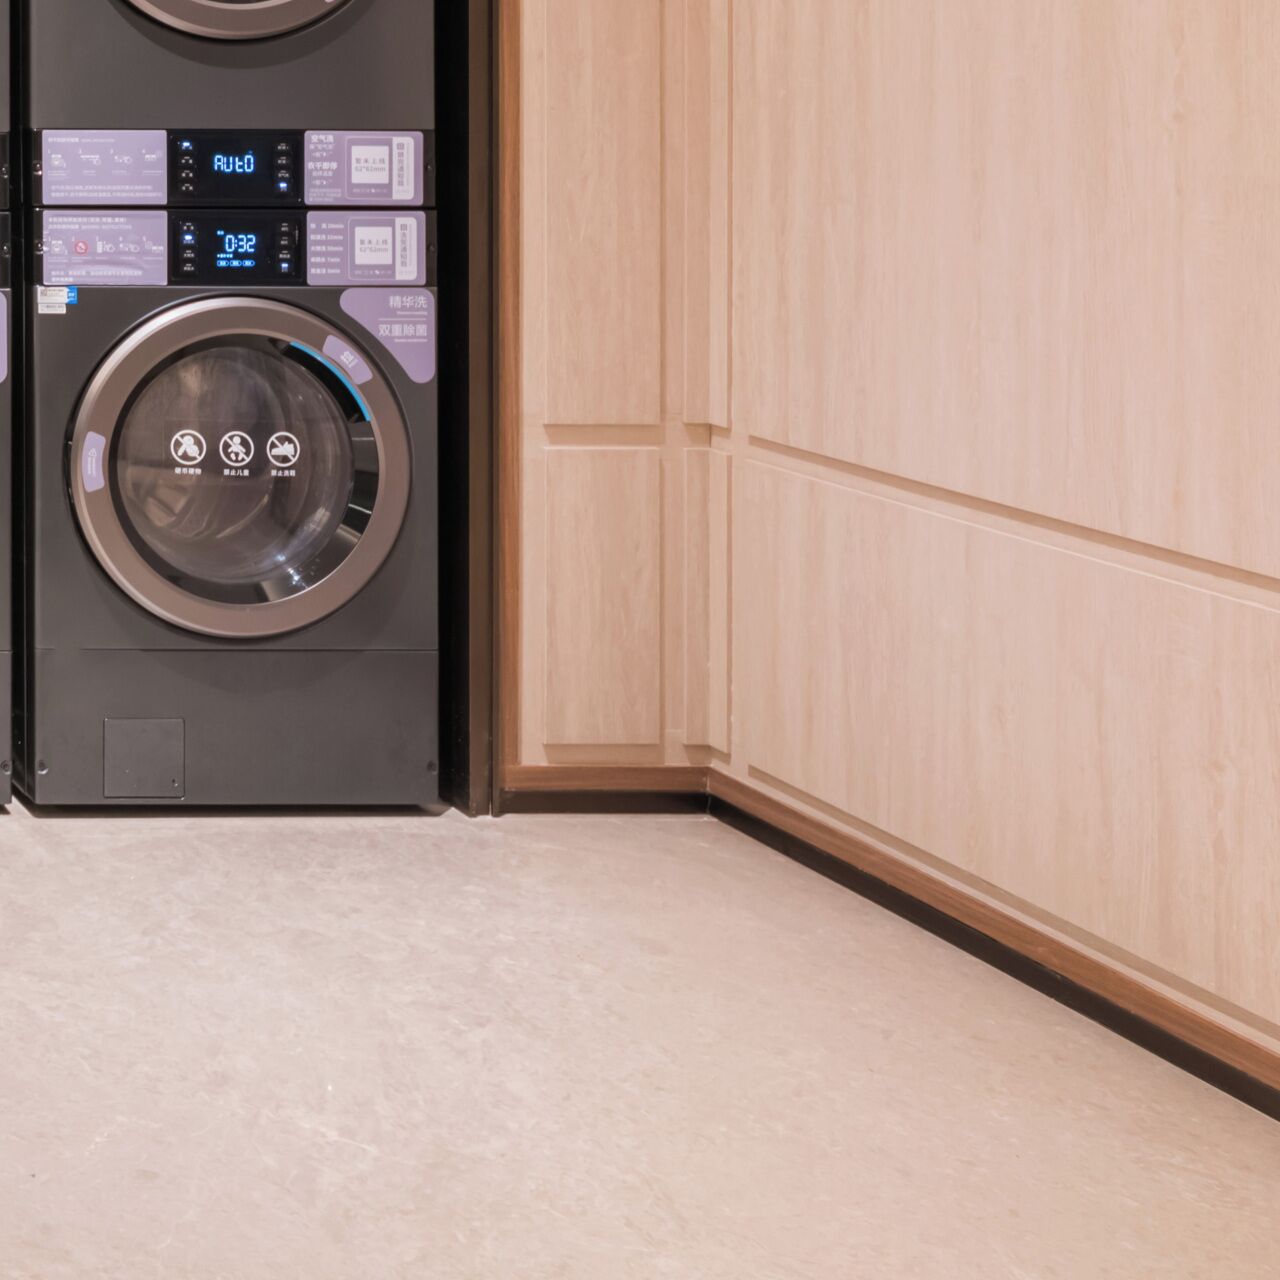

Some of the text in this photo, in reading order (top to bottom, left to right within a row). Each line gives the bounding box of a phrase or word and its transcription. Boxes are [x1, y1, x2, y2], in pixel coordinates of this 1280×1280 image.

[225, 235, 256, 253] 0:32
[389, 296, 427, 308] 精华洗
[378, 324, 427, 336] 双重除菌
